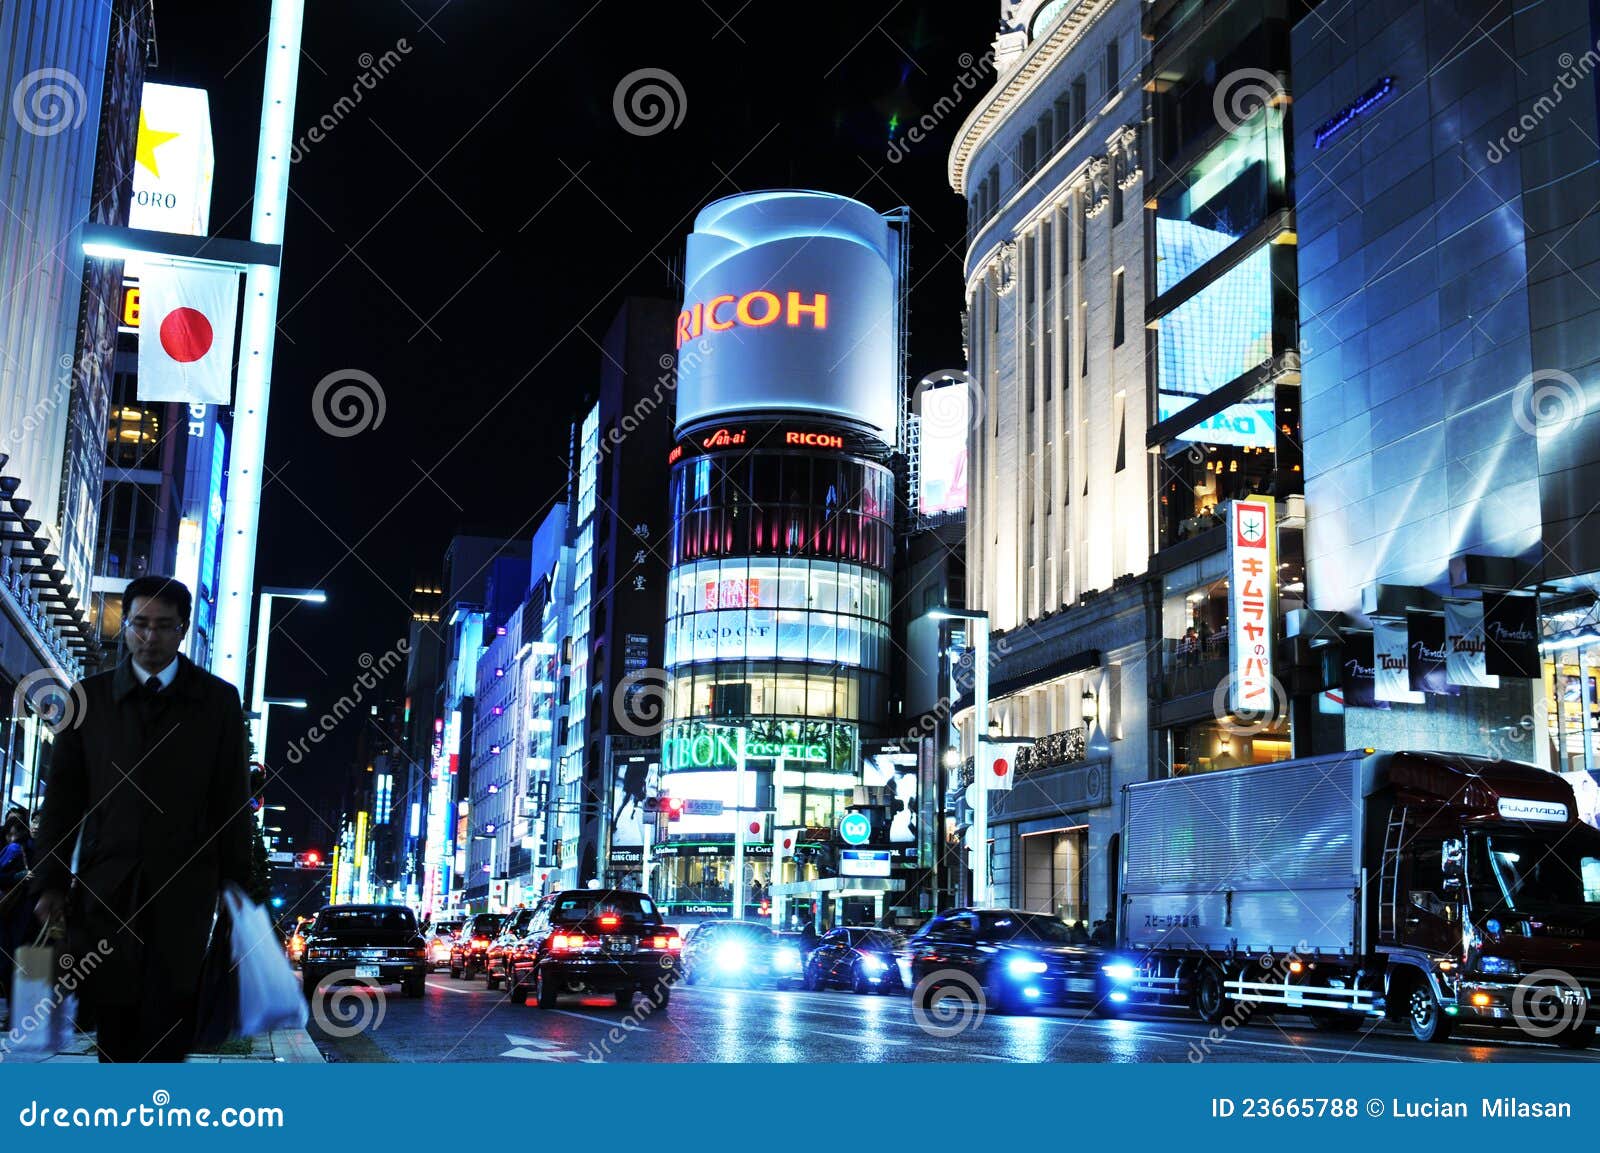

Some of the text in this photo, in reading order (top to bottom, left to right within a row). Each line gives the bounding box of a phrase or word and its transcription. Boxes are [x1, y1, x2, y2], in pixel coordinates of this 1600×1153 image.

[131, 189, 176, 208] ORO
[676, 290, 827, 349] RICOH
[786, 432, 842, 448] RICOH
[1241, 557, 1269, 699] キムラヤのパン
